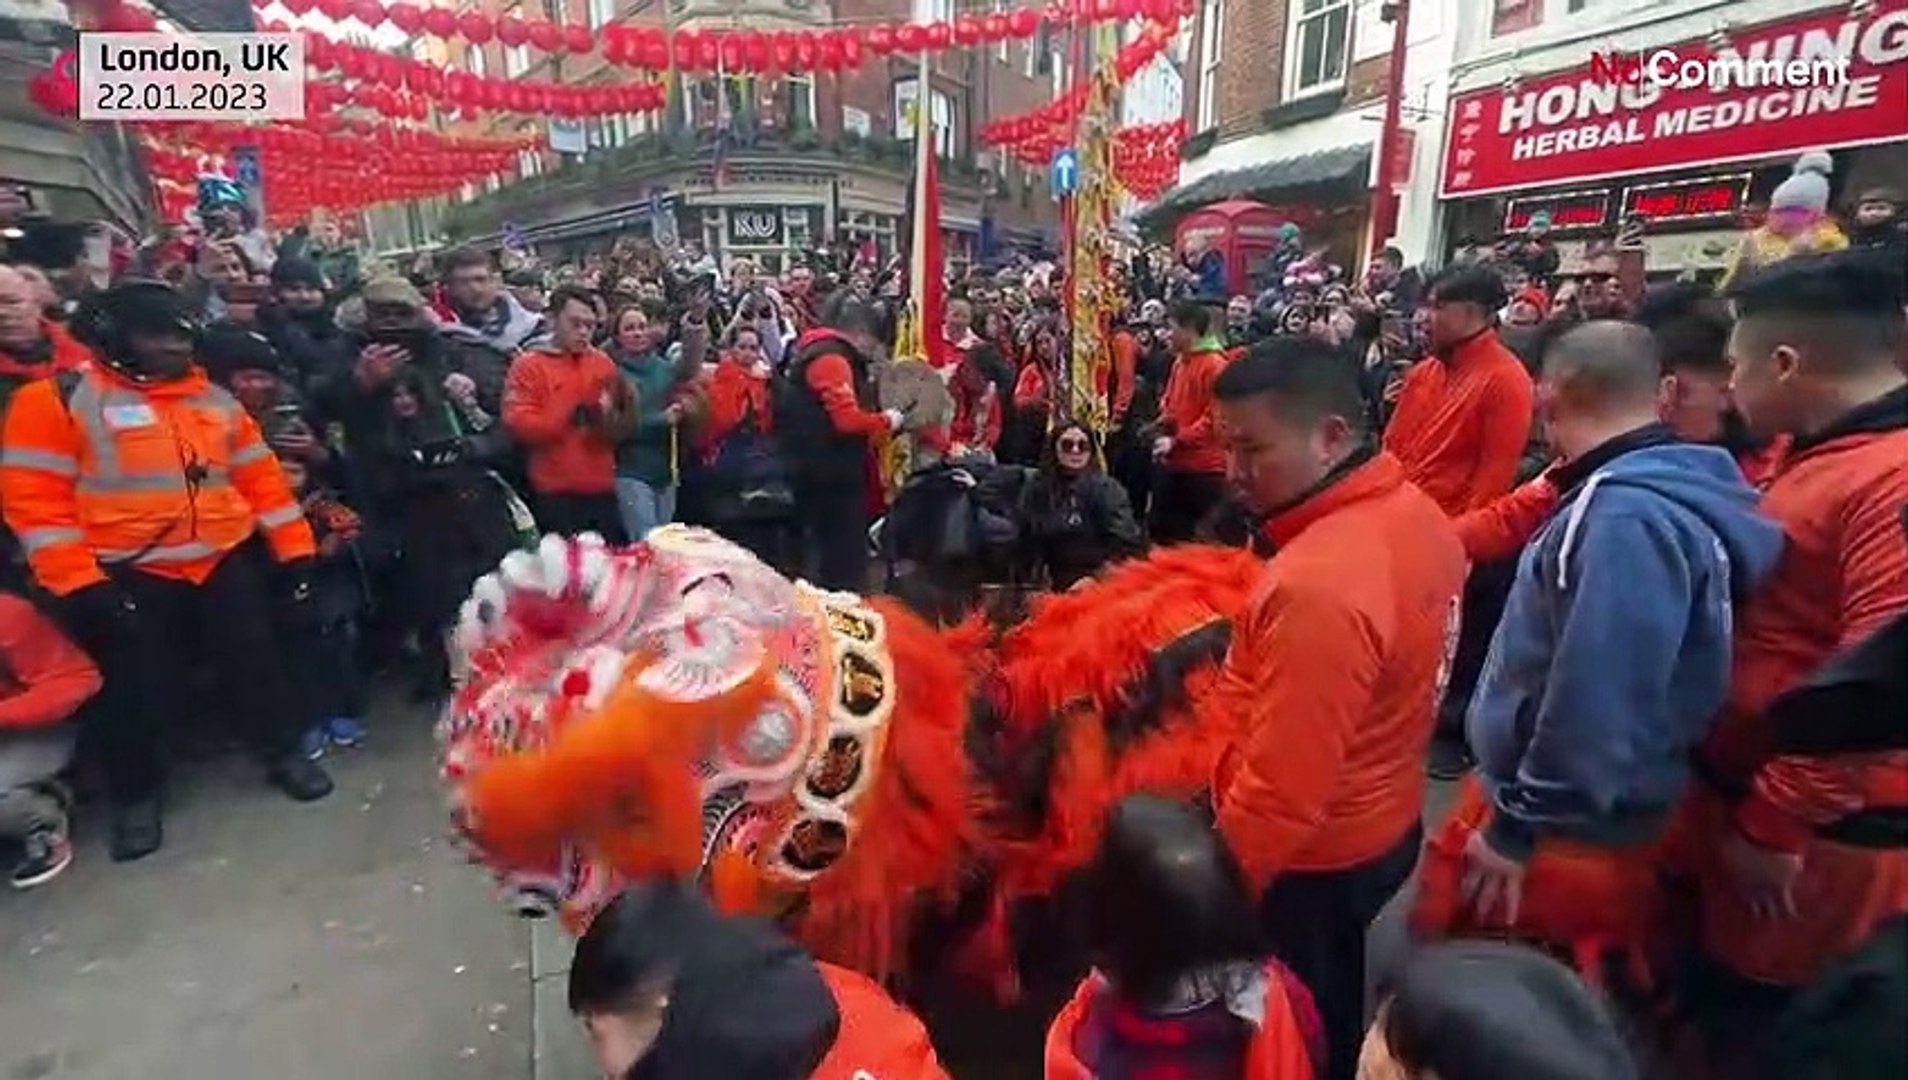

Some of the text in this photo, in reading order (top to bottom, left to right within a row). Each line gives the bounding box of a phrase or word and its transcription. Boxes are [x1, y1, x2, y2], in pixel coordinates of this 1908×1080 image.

[1498, 61, 1662, 135] HONG
[1512, 117, 1645, 161] HERBAL
[1653, 74, 1883, 138] MEDICINE
[733, 211, 777, 238] KU
